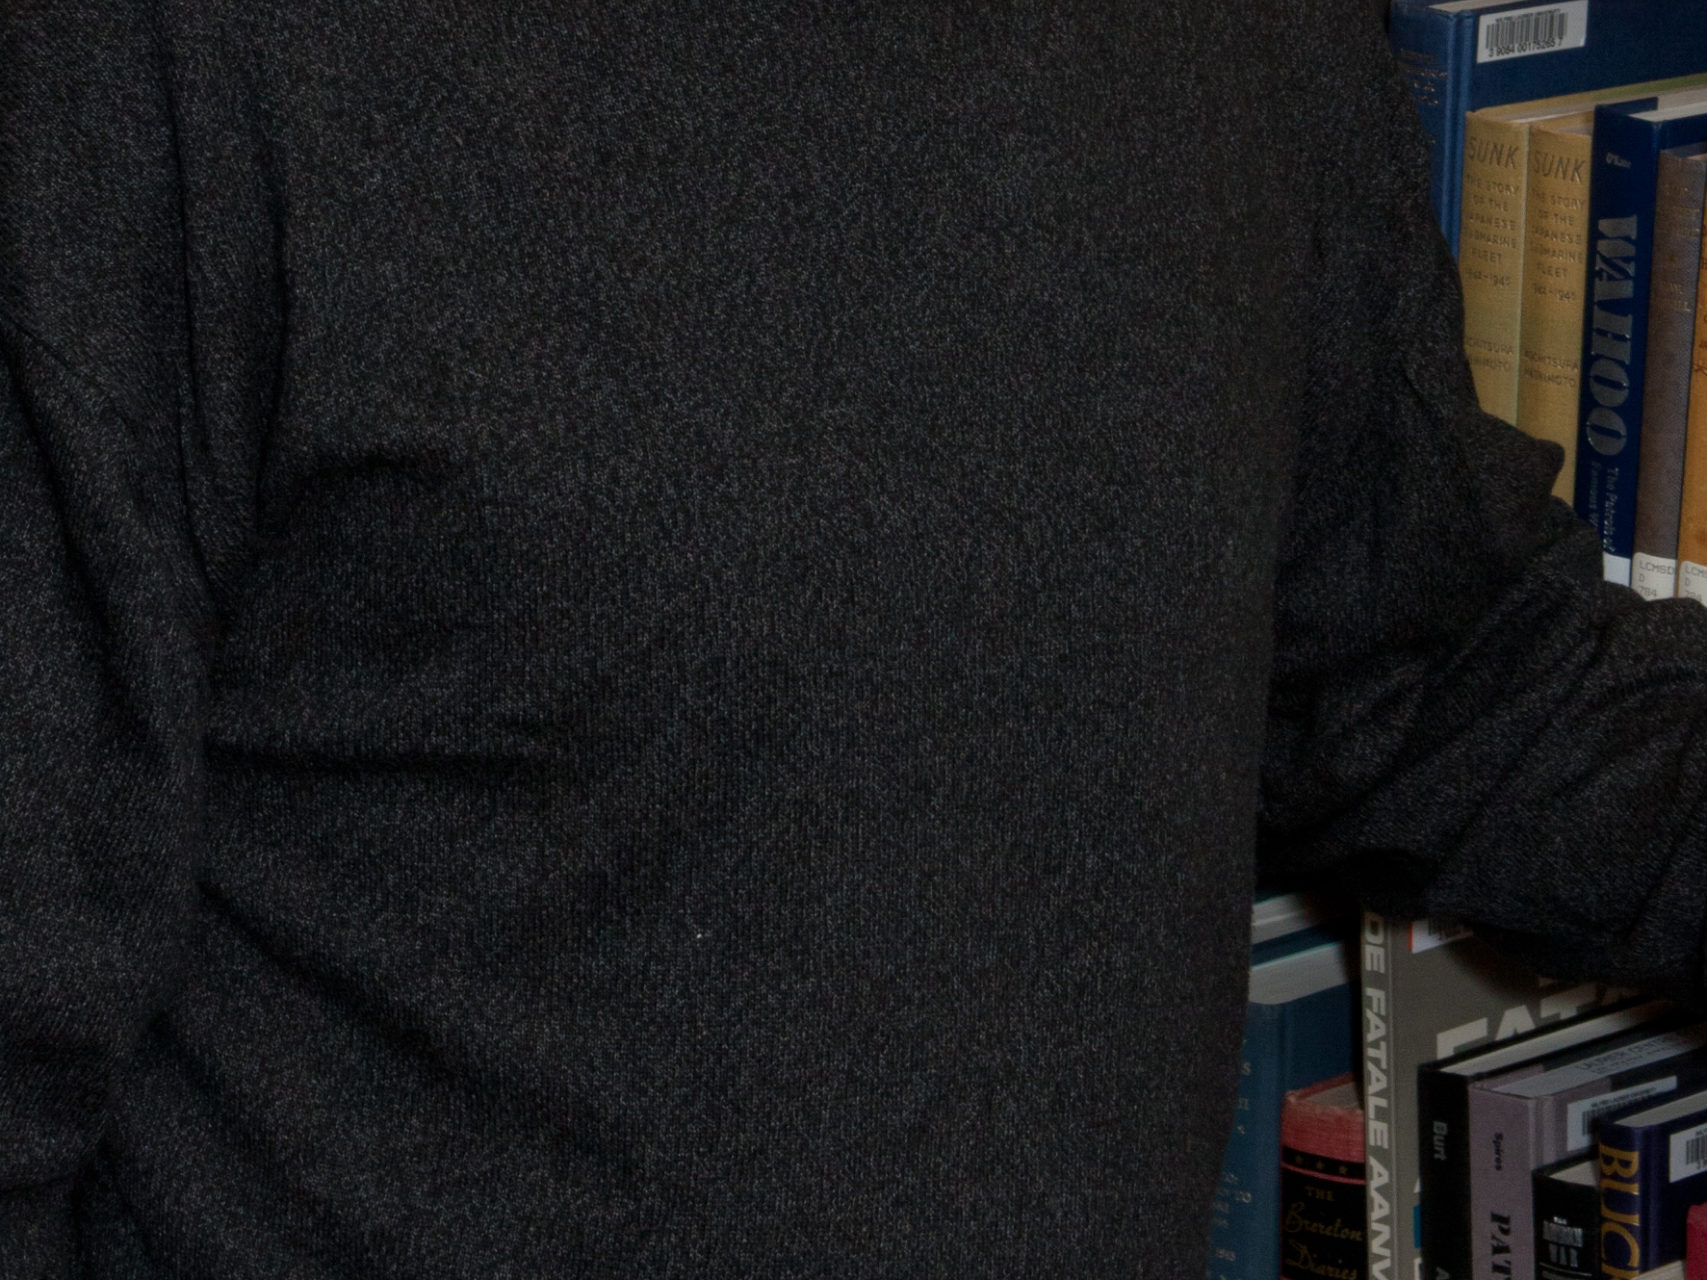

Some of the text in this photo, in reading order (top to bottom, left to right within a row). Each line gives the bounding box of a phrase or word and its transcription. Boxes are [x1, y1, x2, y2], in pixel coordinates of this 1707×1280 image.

[1468, 136, 1520, 170] SUNK
[1533, 149, 1587, 184] SUNK
[1485, 179, 1521, 195] STORY
[1550, 195, 1587, 212] STORY
[1488, 198, 1510, 212] THE
[1553, 212, 1575, 226] THE
[1471, 247, 1503, 264] FLEET
[1585, 213, 1638, 457] WAHOO
[1639, 559, 1678, 577] LCMSD
[1685, 562, 1707, 579] LCM
[1363, 912, 1386, 975] DE
[1364, 986, 1390, 1151] FATALE
[1432, 1120, 1449, 1162] Burt
[1303, 1183, 1336, 1202] THE
[1284, 1200, 1364, 1242] Brereton
[1284, 1237, 1359, 1280] Diaries
[1490, 1210, 1513, 1280] PAT
